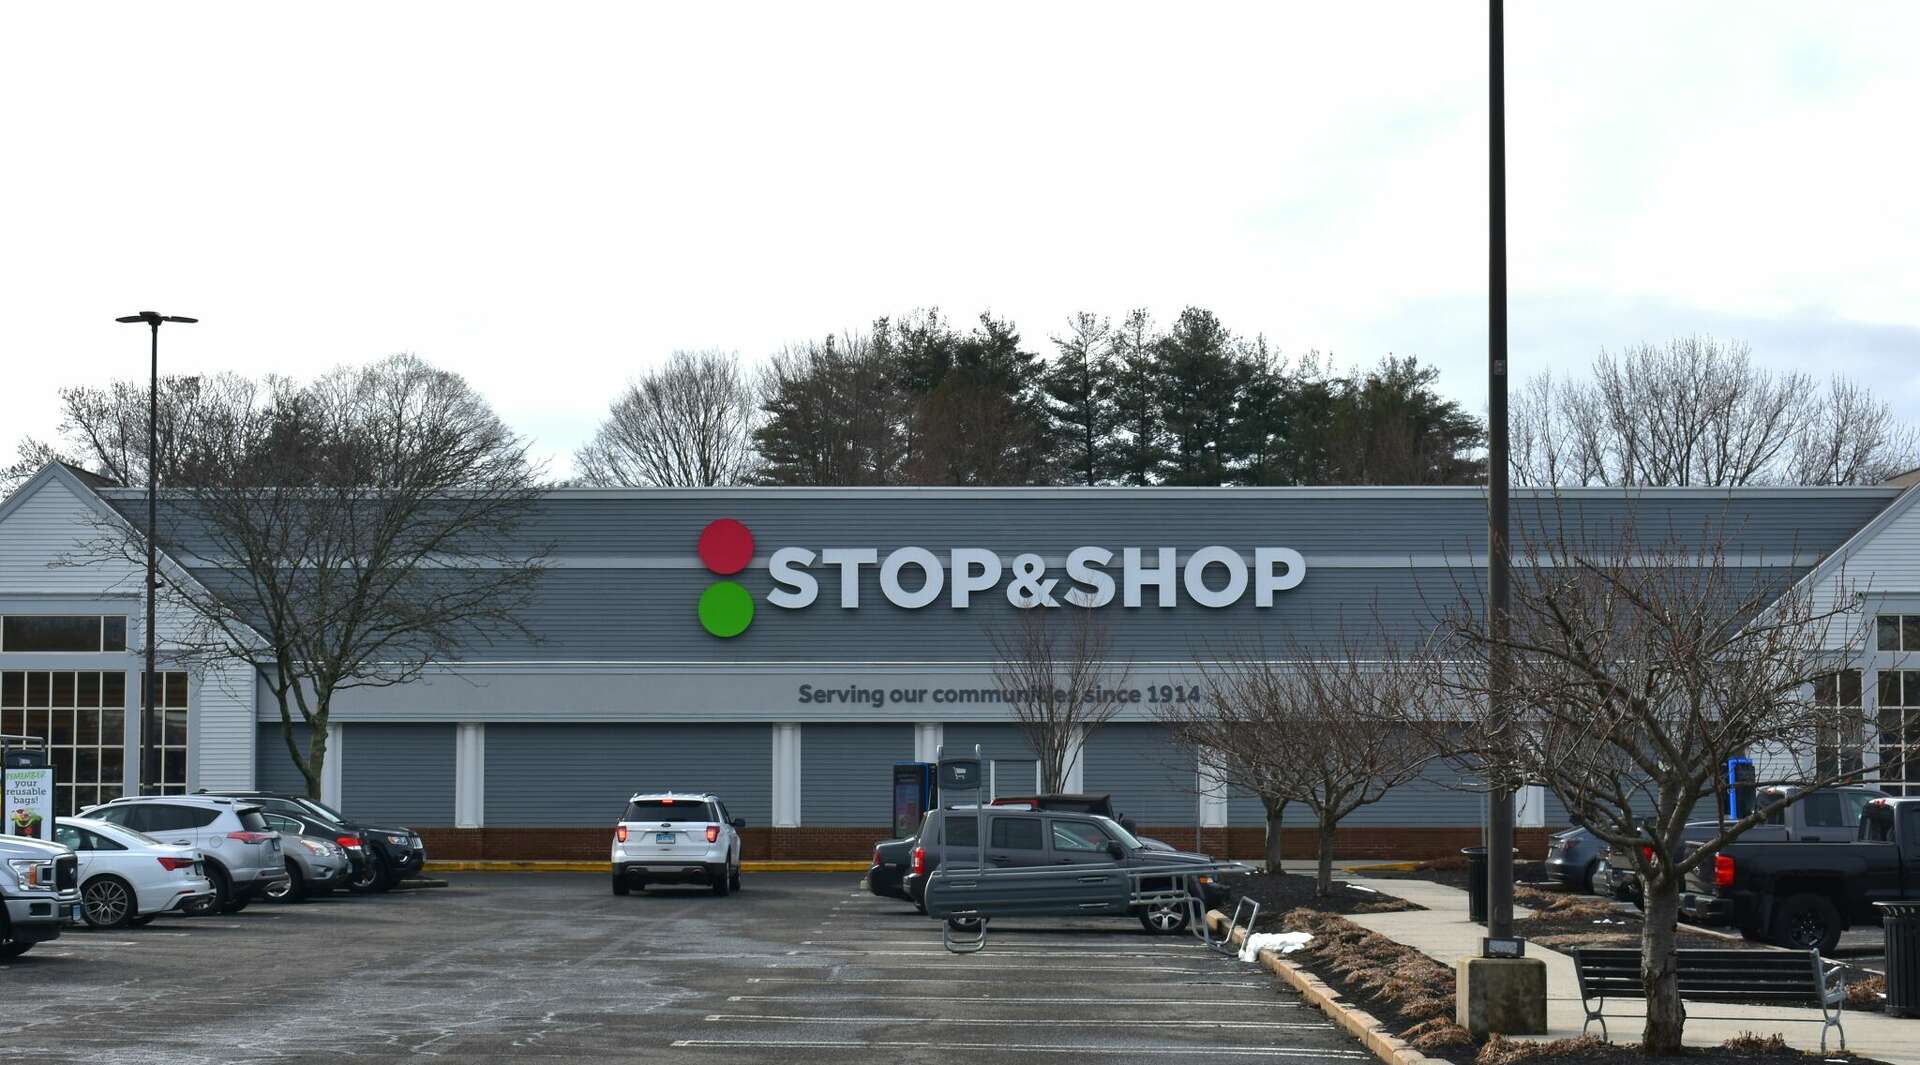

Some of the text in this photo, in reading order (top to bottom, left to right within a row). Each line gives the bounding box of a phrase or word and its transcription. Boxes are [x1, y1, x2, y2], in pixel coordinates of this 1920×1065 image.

[766, 546, 1307, 610] STOP&SHOP
[798, 684, 1200, 708] Serving our communie since 1914
[15, 780, 37, 788] your
[6, 787, 47, 796] reusable
[13, 795, 39, 805] bags!
